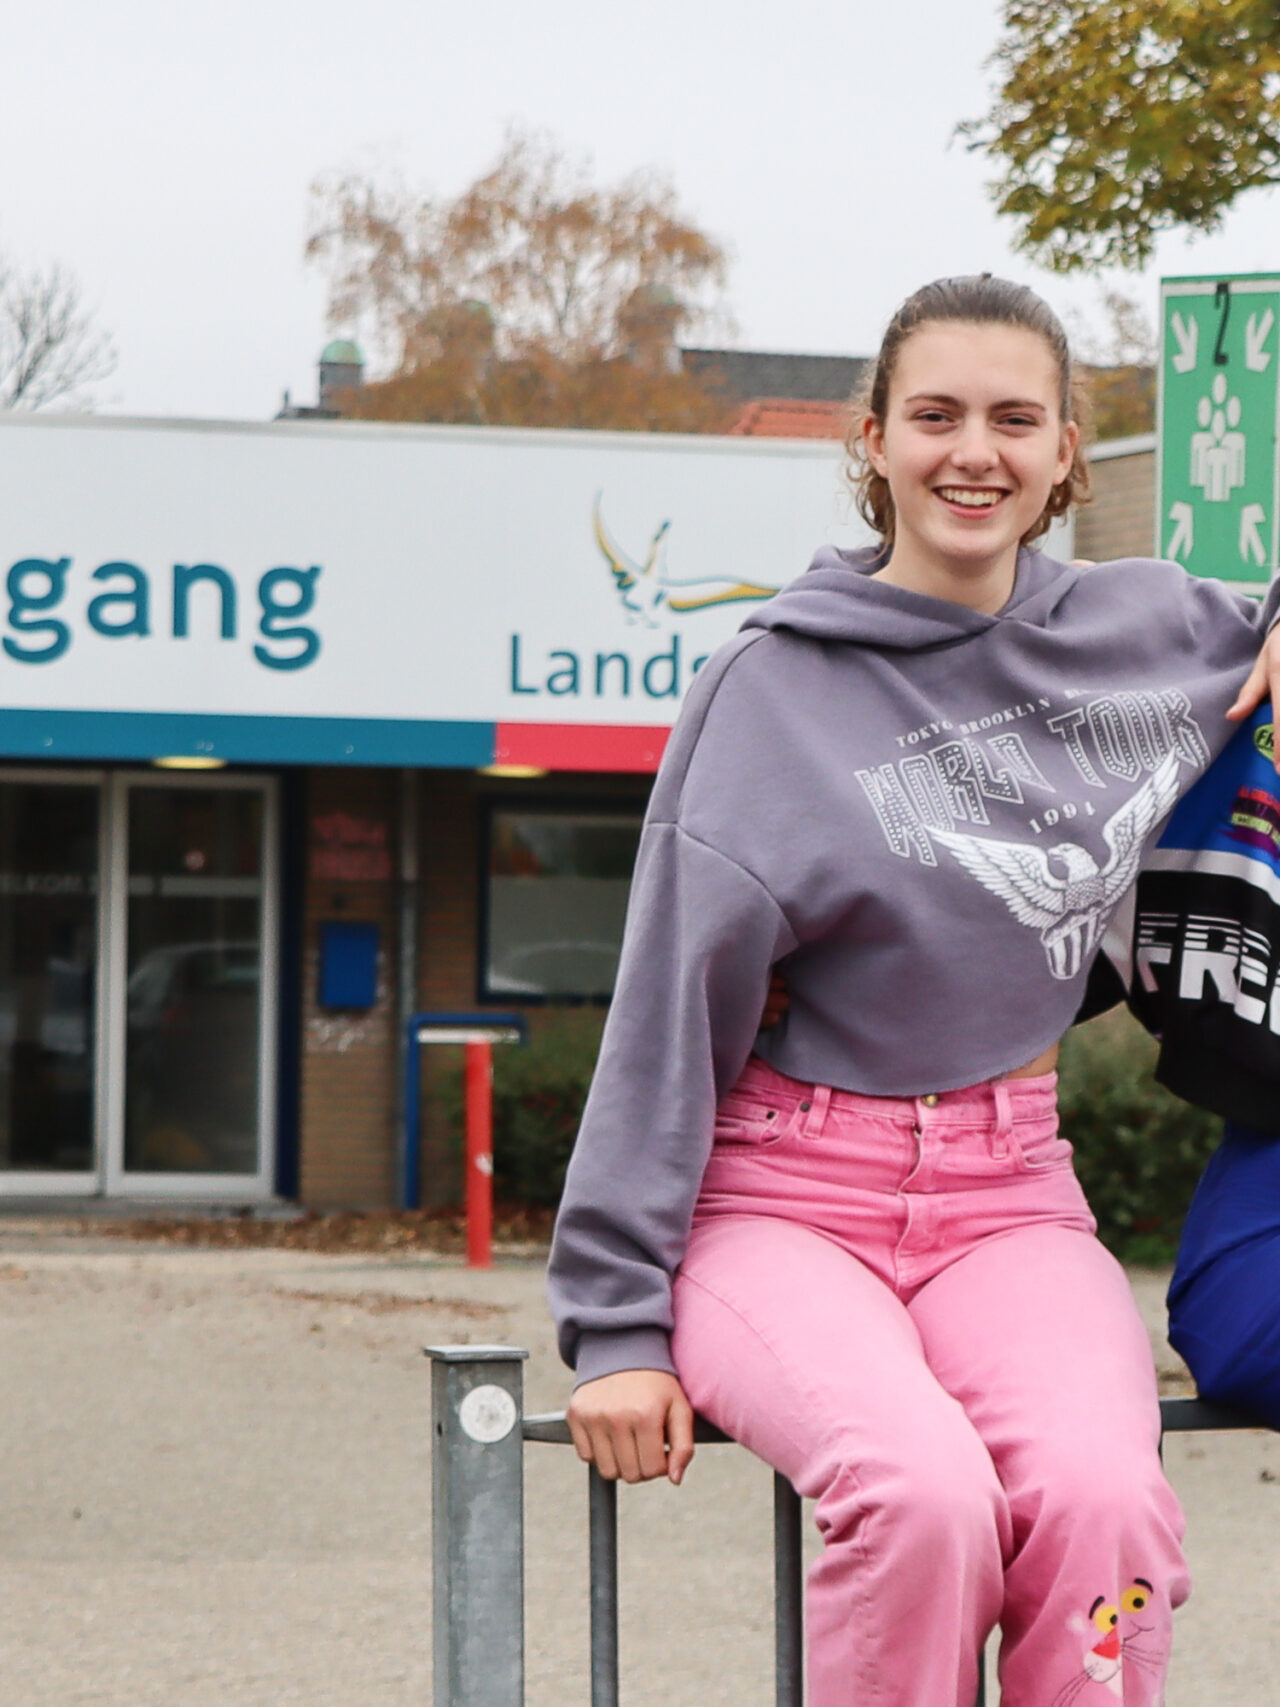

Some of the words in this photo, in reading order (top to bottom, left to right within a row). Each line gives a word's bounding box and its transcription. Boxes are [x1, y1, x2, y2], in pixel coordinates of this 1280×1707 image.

[1214, 282, 1230, 366] 2
[1, 556, 322, 673] gang
[896, 720, 953, 748] TOKYO
